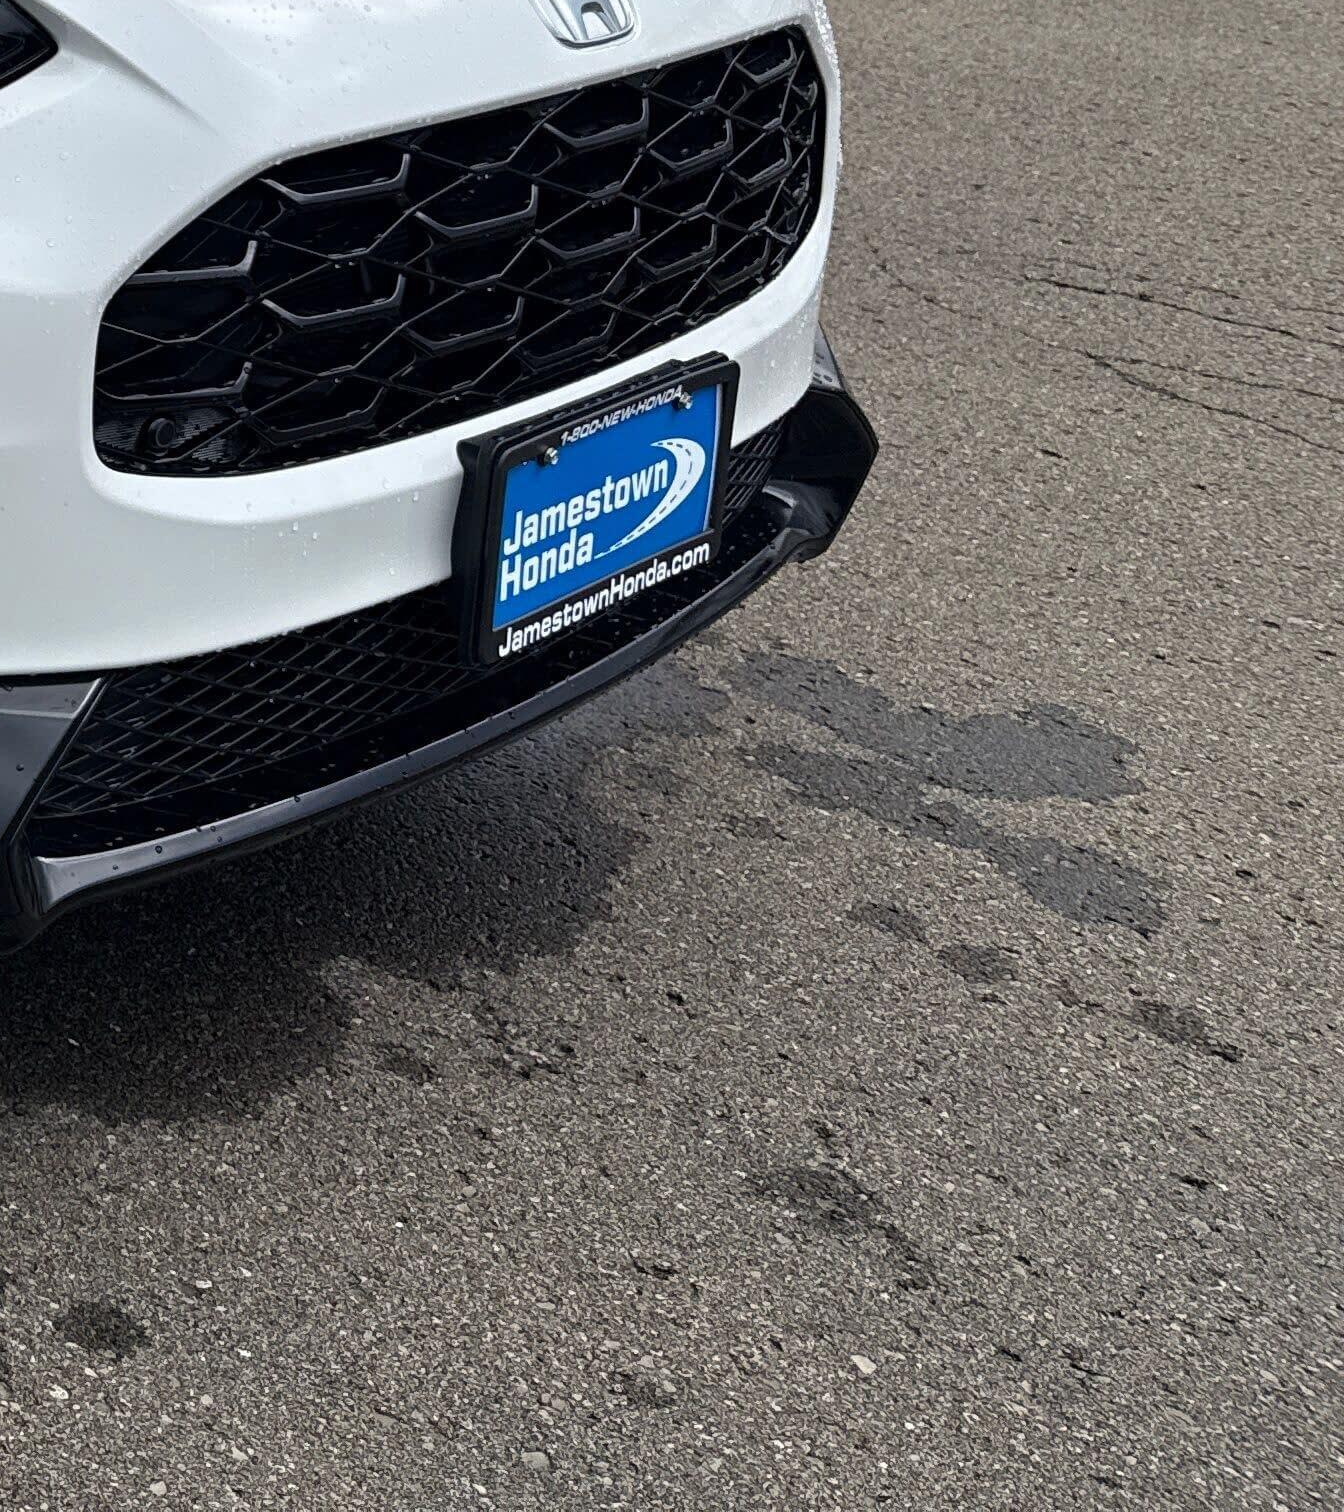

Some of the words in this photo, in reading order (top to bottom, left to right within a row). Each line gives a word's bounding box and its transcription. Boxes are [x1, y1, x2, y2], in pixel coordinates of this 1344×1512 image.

[561, 384, 684, 446] 1-800-NEW-HONDA
[503, 459, 668, 556] Jamestown
[498, 542, 710, 657] JamestownHonda.com
[499, 529, 594, 602] Honda
